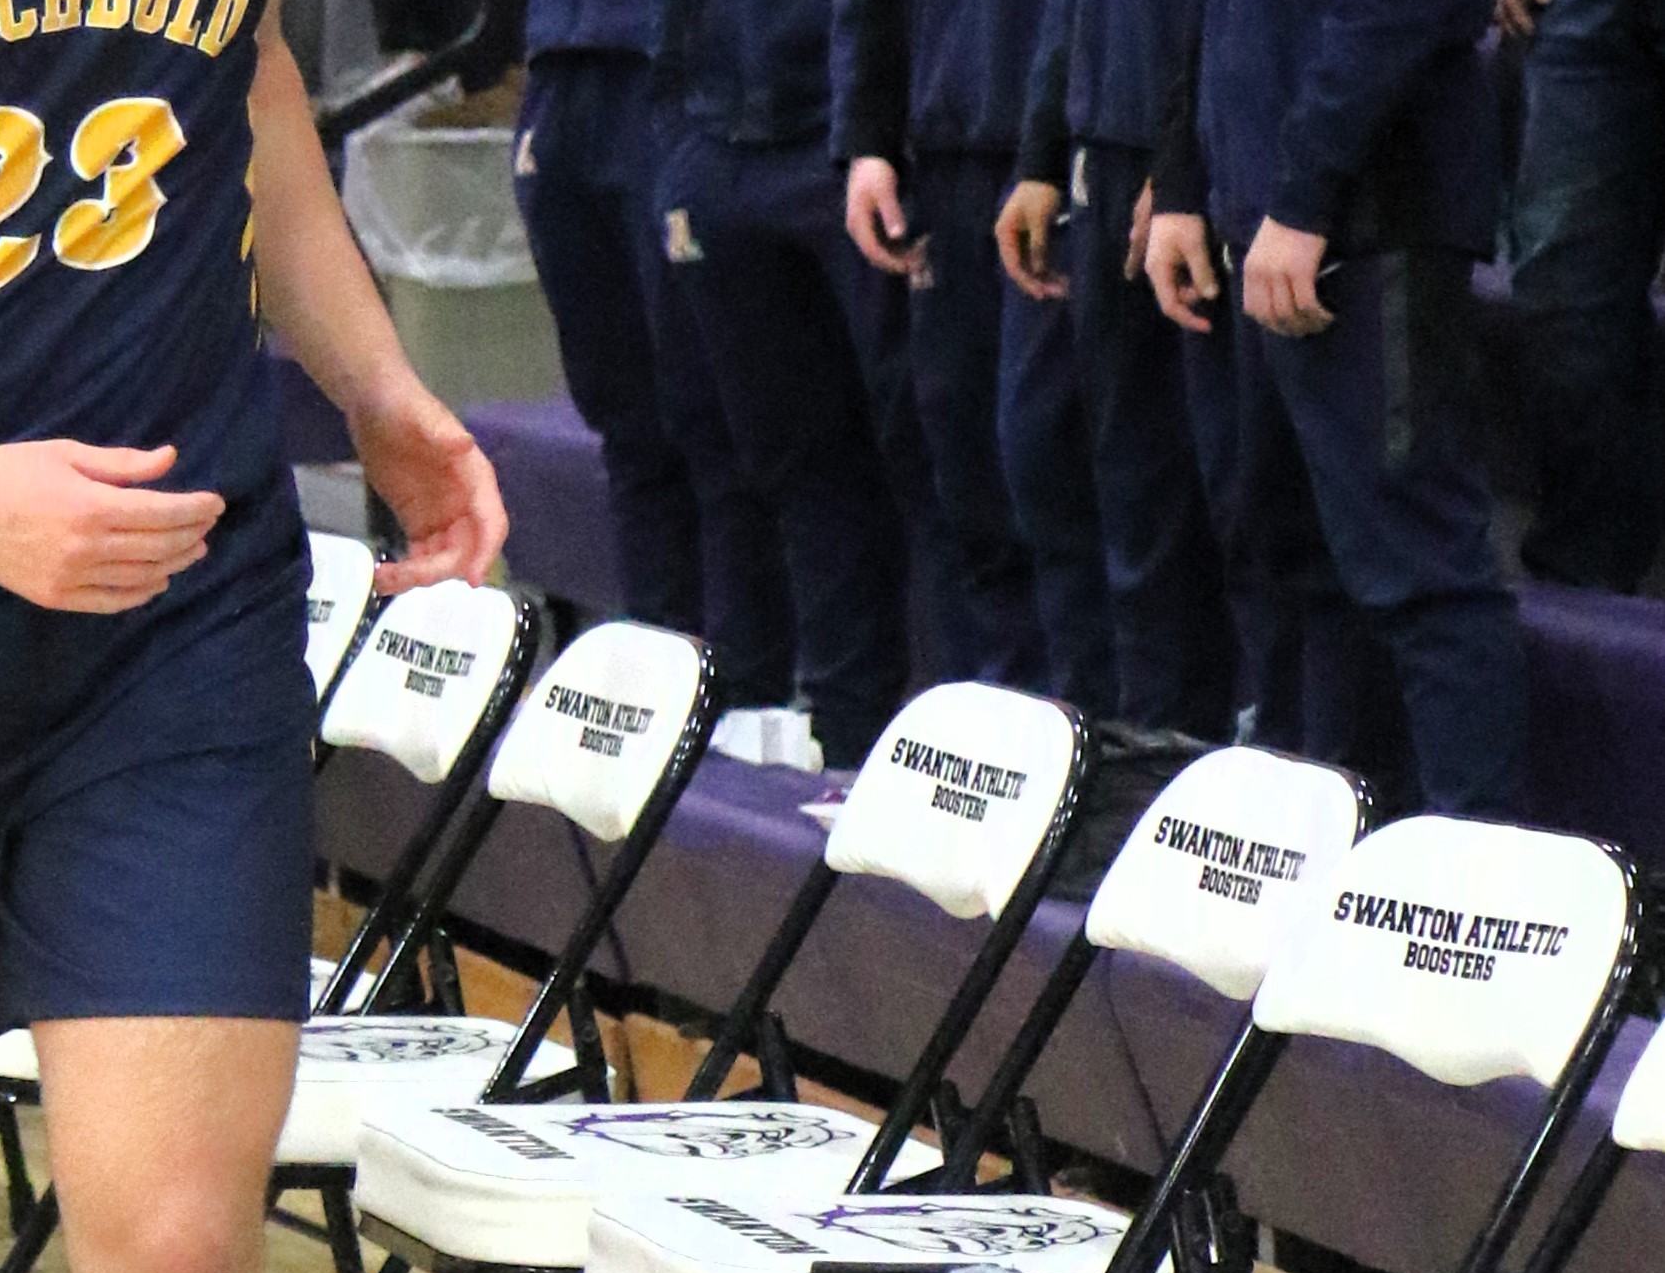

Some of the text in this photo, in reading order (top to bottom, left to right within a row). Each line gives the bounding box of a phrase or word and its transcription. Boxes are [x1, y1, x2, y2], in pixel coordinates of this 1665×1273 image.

[375, 629, 435, 671] SWANTON
[544, 684, 615, 729] SWANTON
[890, 737, 973, 789] SWANTON
[931, 784, 988, 823] BOOSTERS
[1153, 815, 1245, 870] SWANTON
[1198, 864, 1263, 906] BOOSTERS
[1333, 890, 1570, 957] SWANTON ATHLETIC
[1402, 940, 1497, 982] BOOSTERS
[429, 1107, 577, 1160] SWANTON
[664, 1197, 830, 1254] SWANTON
